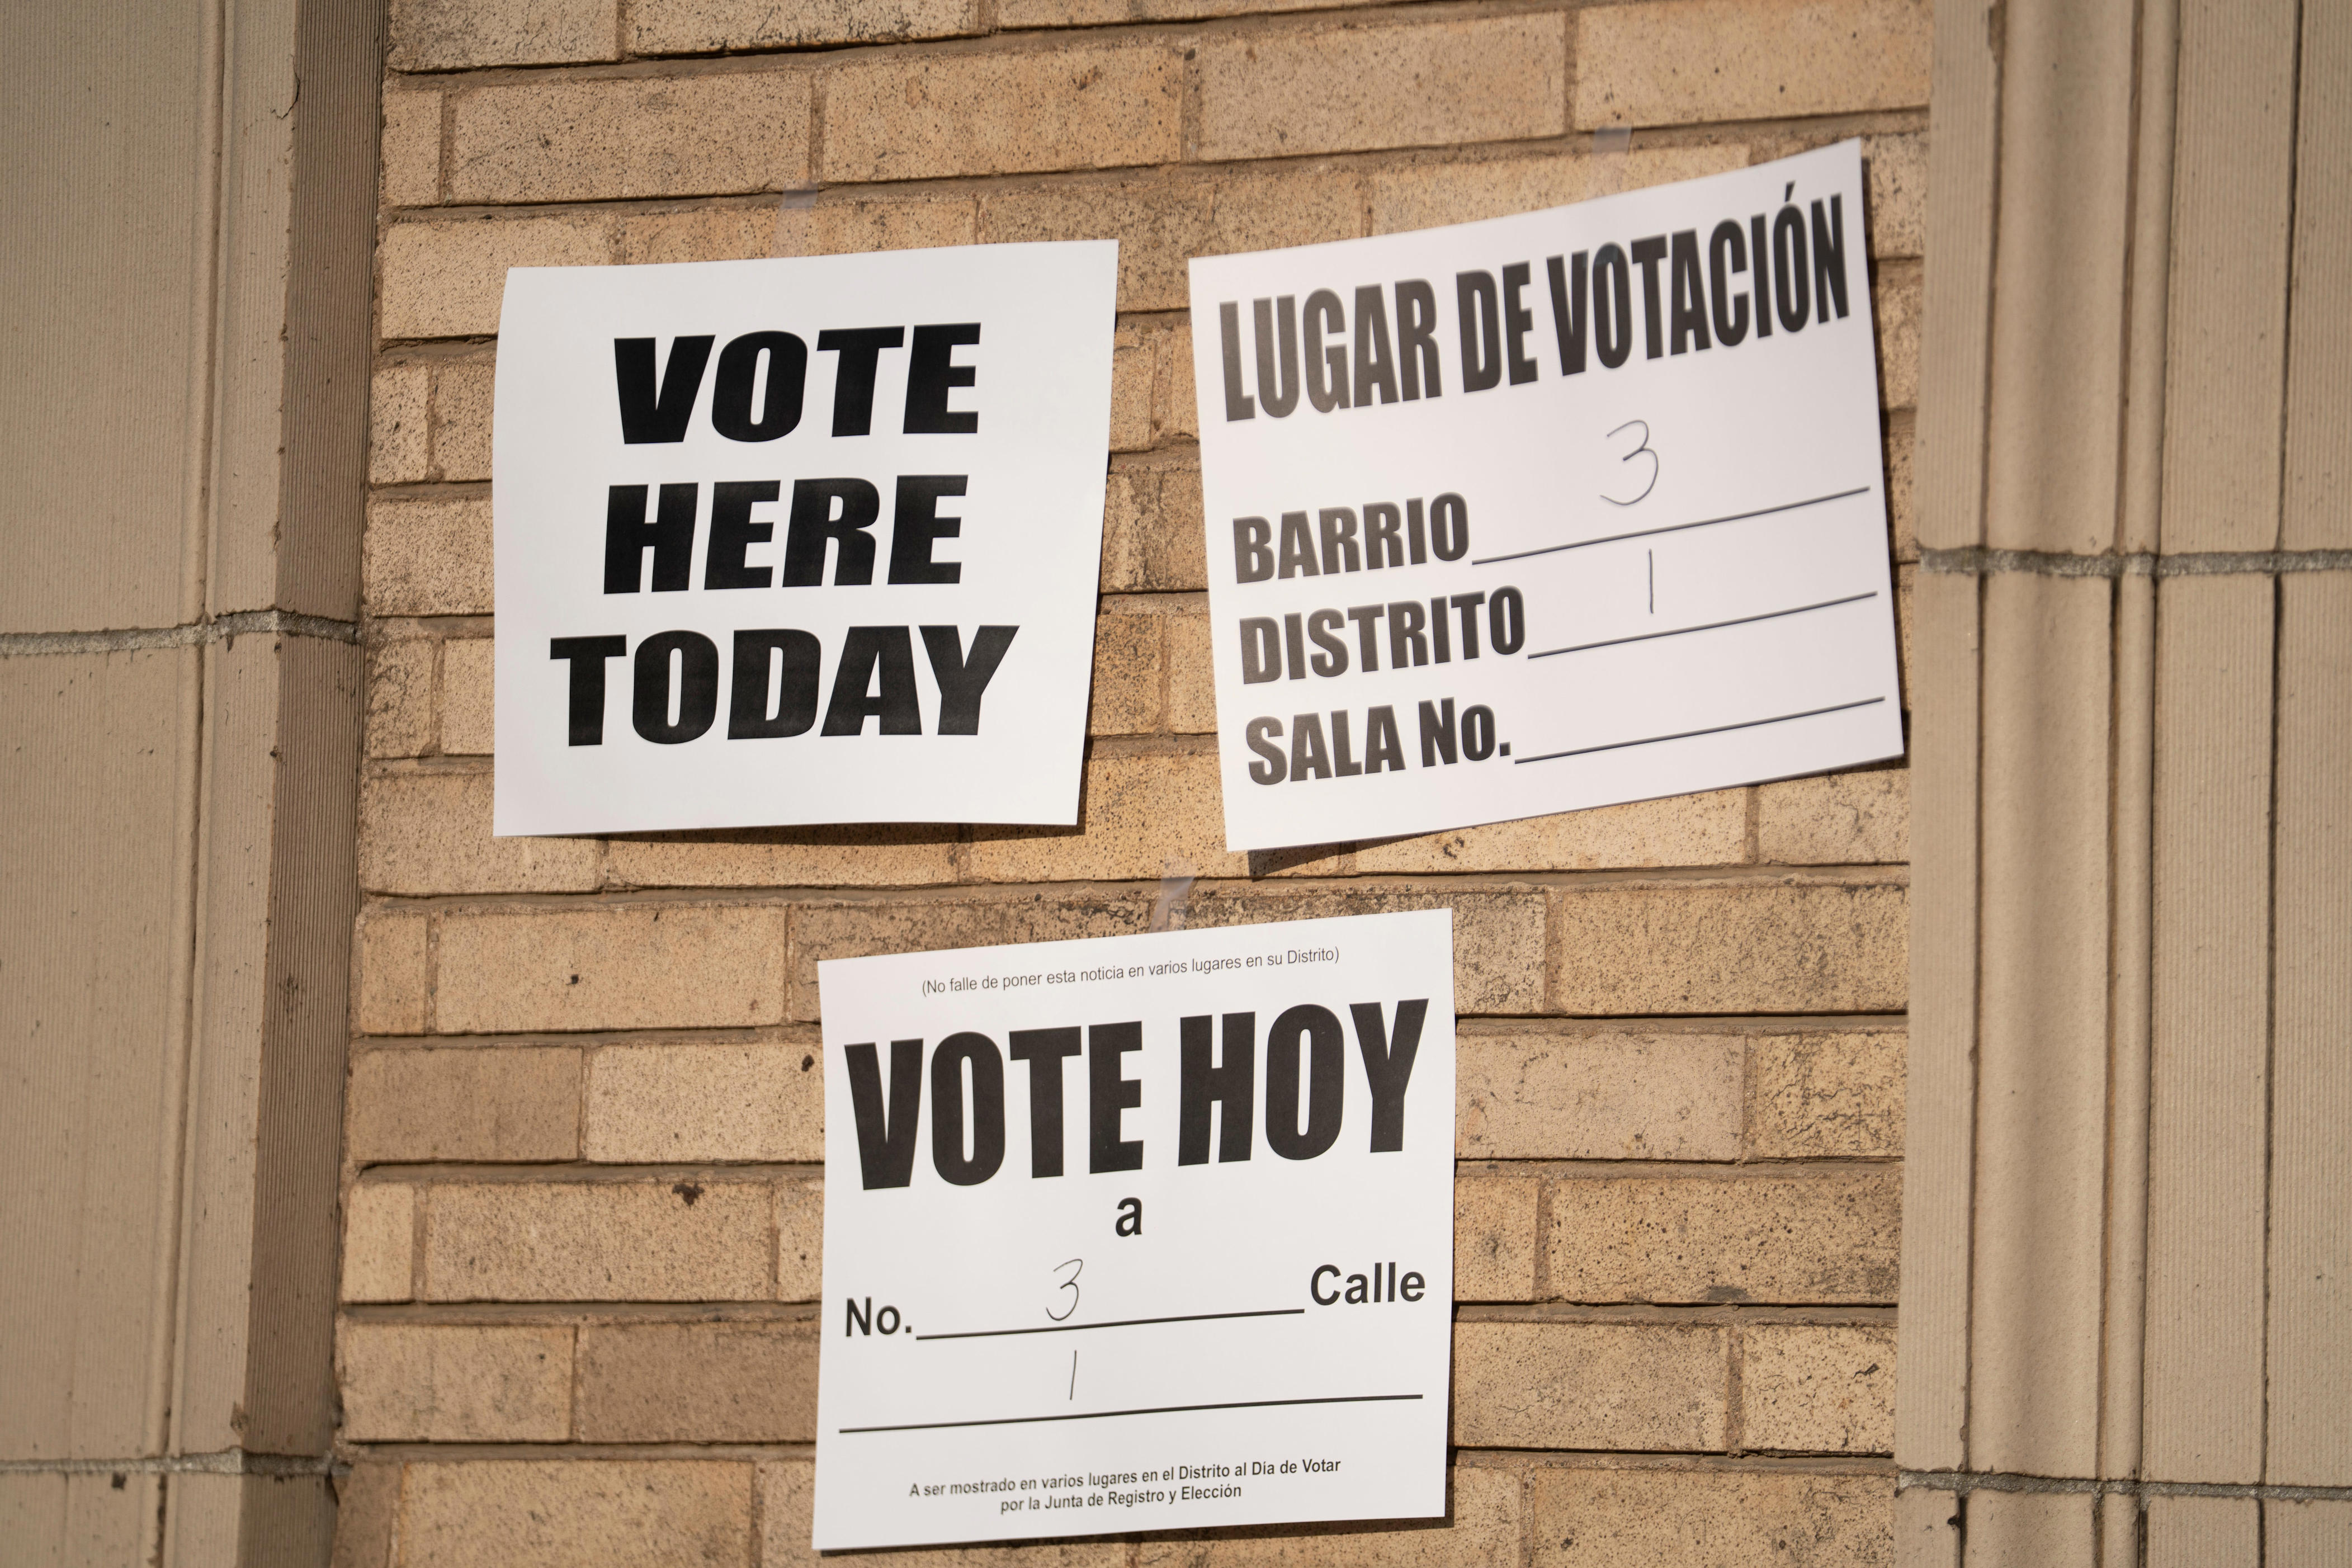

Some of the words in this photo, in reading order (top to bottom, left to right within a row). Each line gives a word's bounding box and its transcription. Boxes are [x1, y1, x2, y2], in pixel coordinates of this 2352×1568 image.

[1218, 281, 1443, 423] LUGAR
[1455, 261, 1539, 394] DE
[1545, 181, 1850, 377] VOTACIÓN
[614, 322, 981, 445] VOTE
[1600, 419, 1659, 506] 3
[603, 474, 969, 595] HERE
[1232, 493, 1471, 584] BARRIO
[1239, 586, 1526, 685] DISTRITO
[549, 625, 1021, 748] TODAY
[1245, 705, 1406, 786] SALA
[1417, 697, 1512, 769] No.
[922, 979, 946, 998] (No
[950, 976, 978, 993] falle
[981, 974, 999, 990] de
[1002, 974, 1043, 991] poner
[1046, 969, 1076, 985] esta
[1080, 965, 1125, 982] noticia
[1128, 966, 1145, 979] en
[1149, 960, 1188, 976] varios
[1192, 957, 1242, 975] lugares
[1246, 955, 1263, 968] en
[1267, 954, 1283, 967] su
[1287, 946, 1340, 969] Distrito)
[843, 1020, 1144, 1191] VOTE
[1177, 998, 1429, 1167] HOY
[1115, 1197, 1142, 1238] a
[846, 1297, 913, 1338] No.
[1046, 1258, 1084, 1322] 3
[1310, 1262, 1425, 1306] Calle
[909, 1484, 921, 1498] A
[923, 1483, 947, 1496] ser
[950, 1477, 1017, 1495] mostrado
[1019, 1479, 1037, 1491] en
[1041, 1473, 1084, 1490] varios
[1088, 1470, 1138, 1490] lugares
[1141, 1470, 1159, 1484] en
[1161, 1465, 1175, 1482] el
[1178, 1463, 1231, 1481] Distrito
[1234, 1461, 1248, 1477] al
[1251, 1460, 1276, 1476] Día
[1279, 1459, 1298, 1475] de
[1301, 1458, 1342, 1473] Votar
[1000, 1499, 1025, 1516] por
[1028, 1496, 1041, 1511] la
[1044, 1494, 1084, 1510] Junta
[1087, 1491, 1104, 1508] de
[1107, 1489, 1165, 1508] Registro
[1168, 1490, 1178, 1505] y
[1180, 1482, 1242, 1501] Elección
